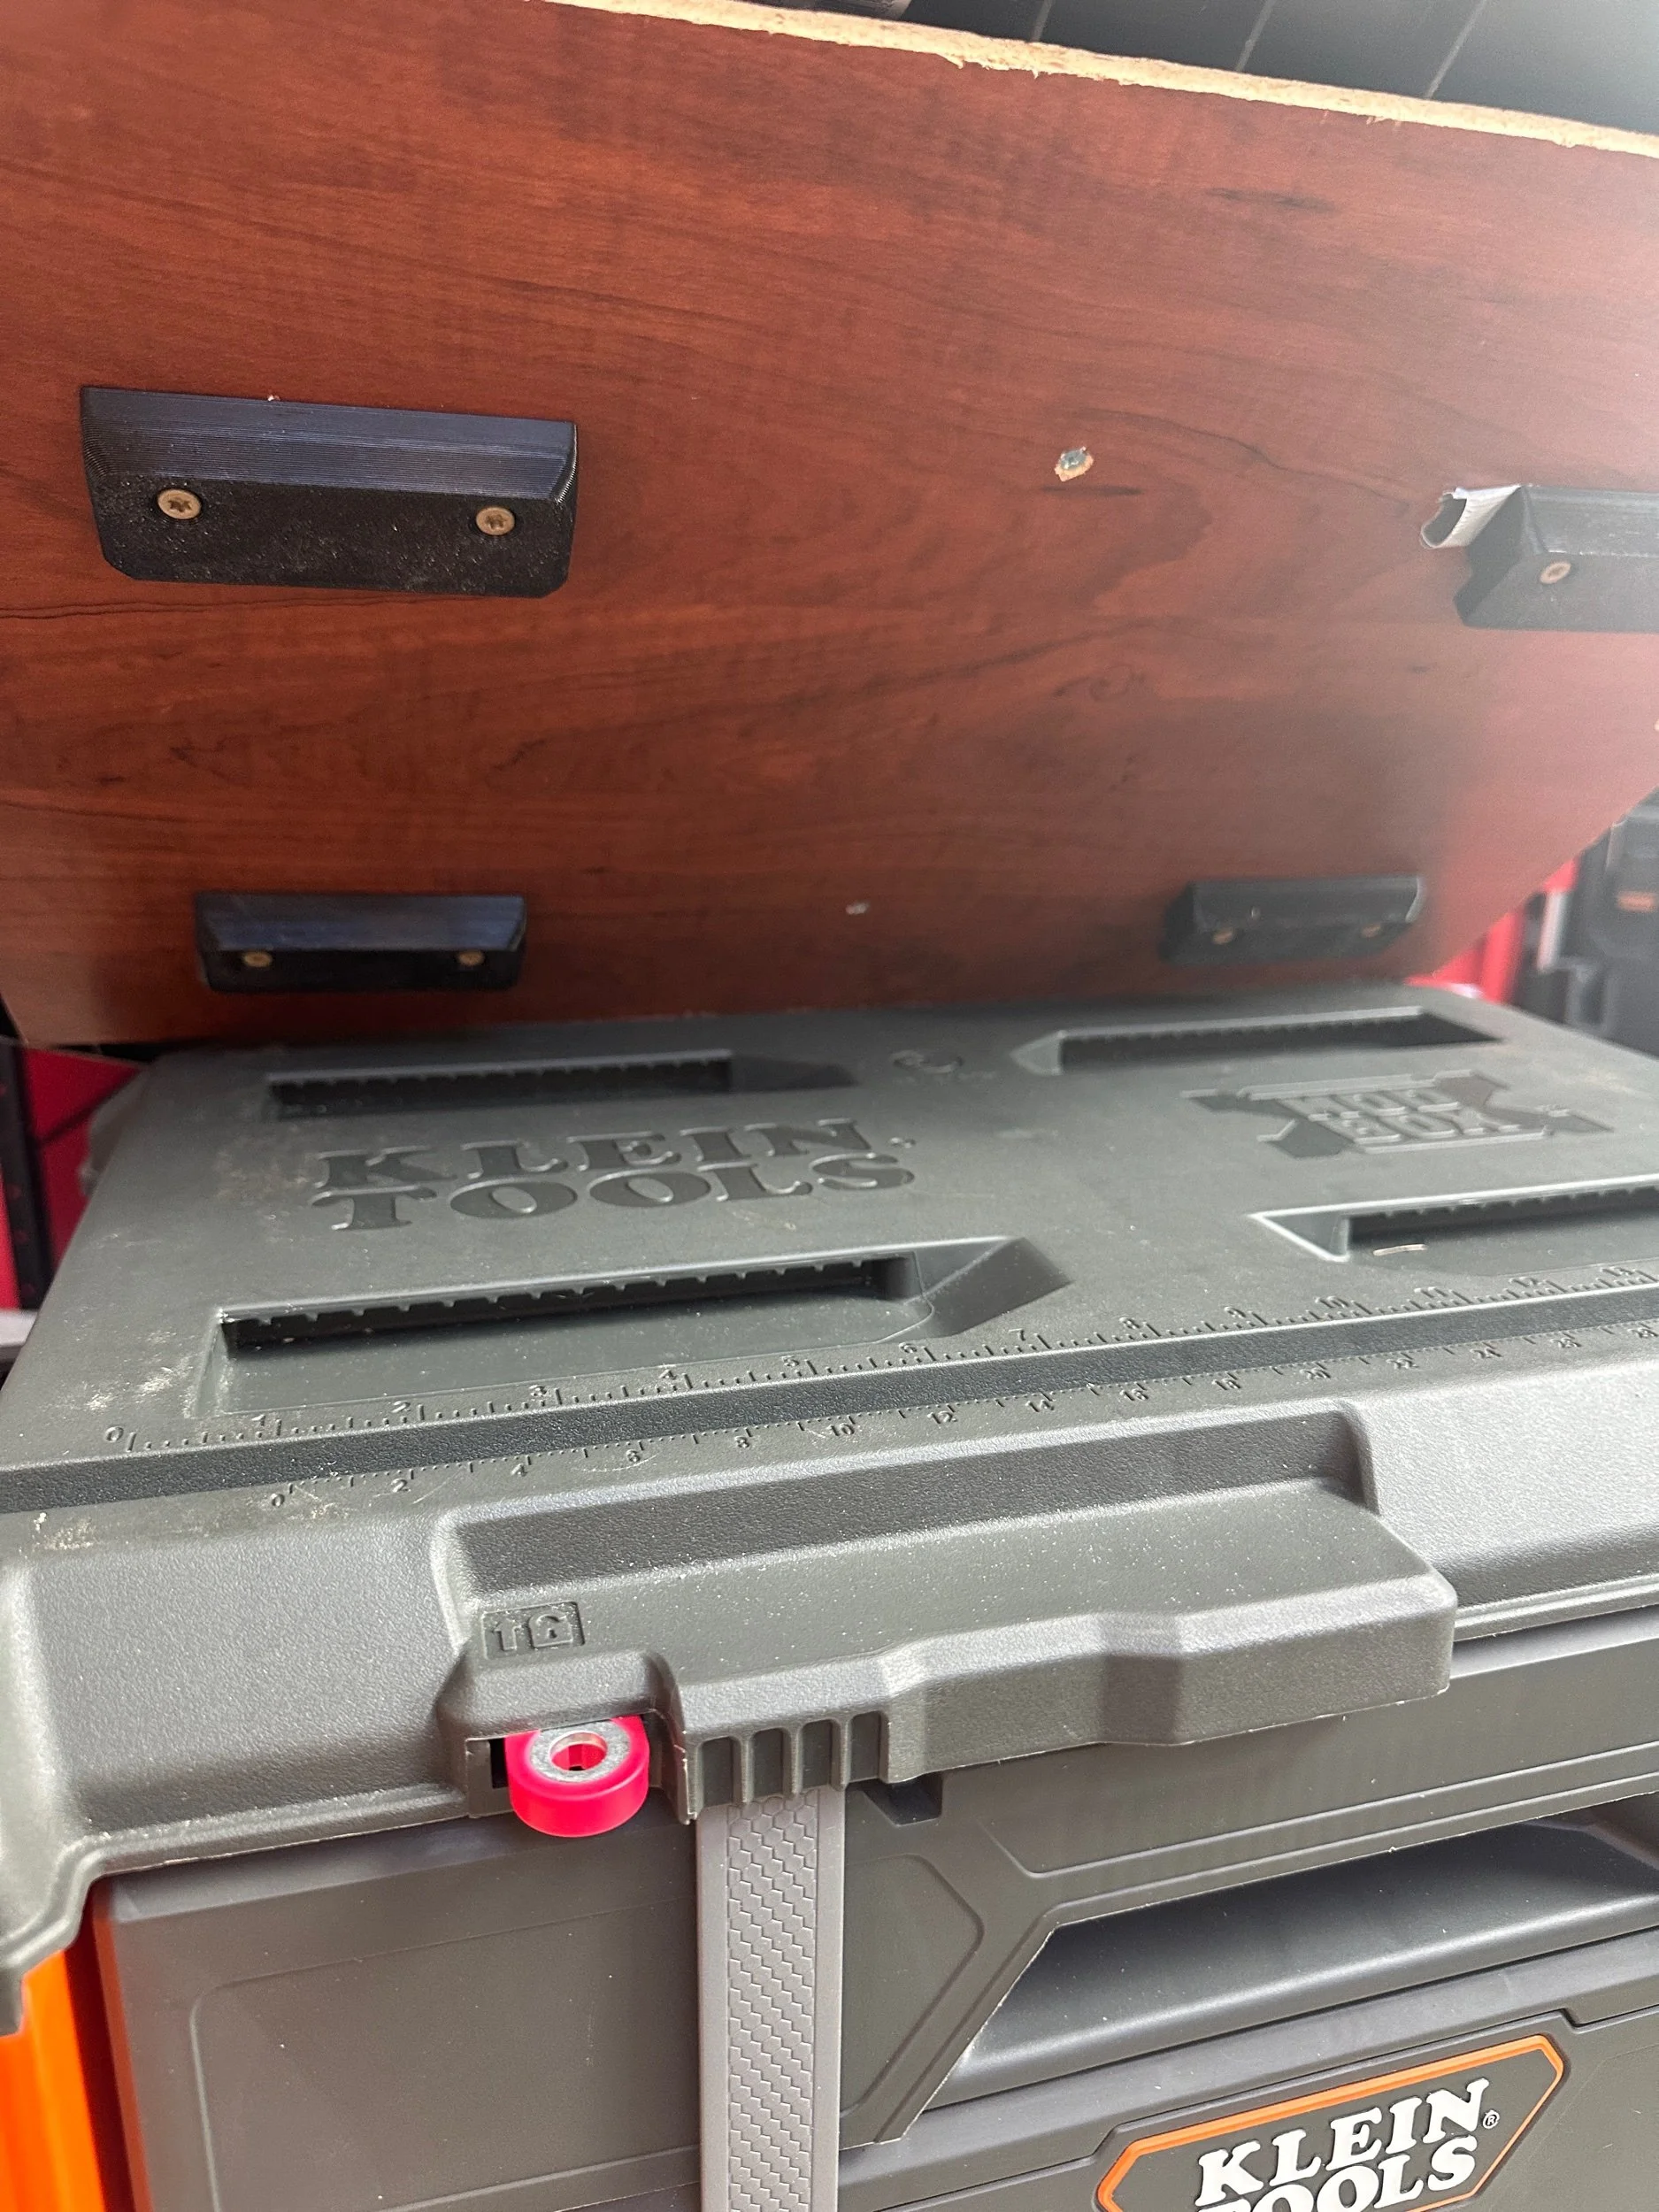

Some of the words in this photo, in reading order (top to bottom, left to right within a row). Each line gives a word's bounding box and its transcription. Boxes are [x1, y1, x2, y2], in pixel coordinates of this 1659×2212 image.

[1273, 1088, 1463, 1122] MOD
[1317, 1110, 1521, 1145] BOX
[310, 1152, 915, 1231] TOOLS
[314, 1118, 874, 1188] KLEIN
[392, 1401, 411, 1413] 2
[781, 1356, 800, 1367] 5
[898, 1342, 918, 1353] 6
[1008, 1328, 1026, 1340] 7
[1119, 1317, 1141, 1329] 8
[1224, 1306, 1247, 1318] 9
[1315, 1295, 1350, 1309] 10
[1414, 1286, 1448, 1298] 11
[1509, 1276, 1542, 1287] 12
[391, 1478, 411, 1493] 2
[511, 1463, 528, 1477] 4
[626, 1449, 641, 1463] 6
[734, 1435, 749, 1448] 8
[827, 1423, 856, 1437] 10
[927, 1410, 958, 1425] 12
[1025, 1399, 1055, 1412] 14
[1119, 1388, 1149, 1402] 16
[1211, 1379, 1241, 1391] 18
[1299, 1368, 1332, 1379] 20
[1386, 1358, 1419, 1371] 22
[1470, 1347, 1503, 1359] 24
[1196, 2135, 1477, 2212] OOLS
